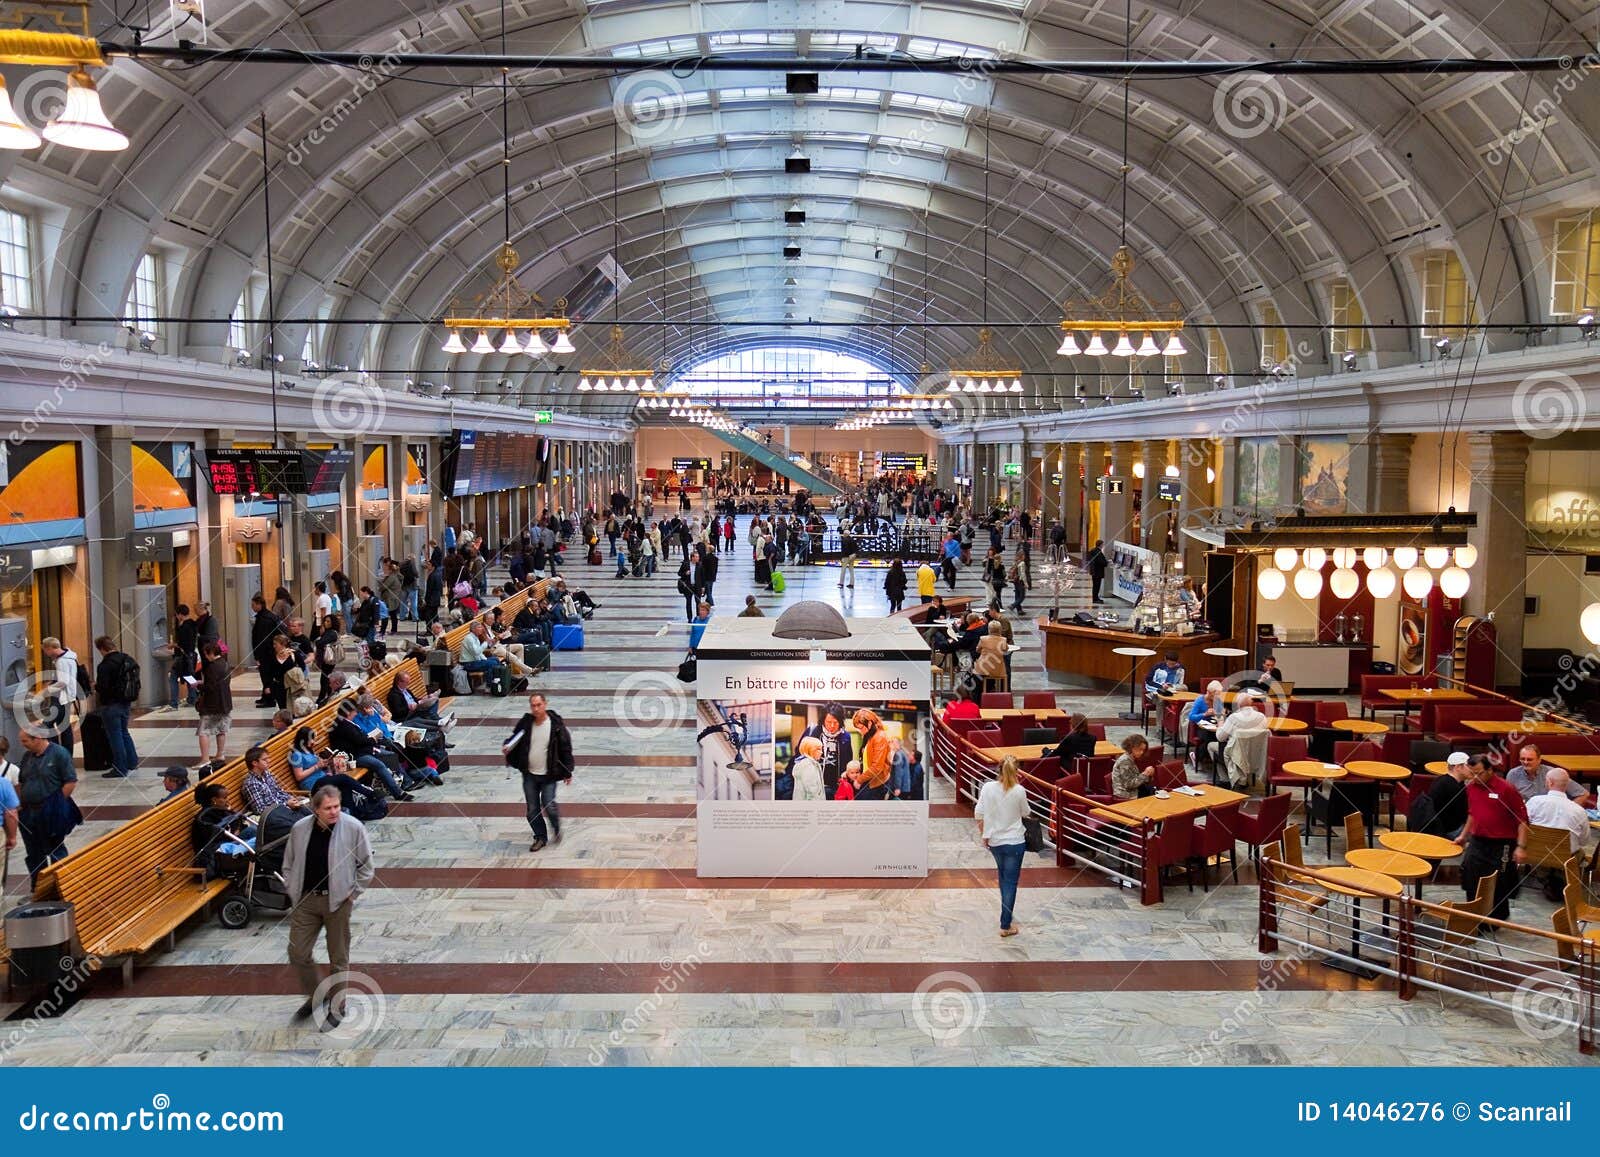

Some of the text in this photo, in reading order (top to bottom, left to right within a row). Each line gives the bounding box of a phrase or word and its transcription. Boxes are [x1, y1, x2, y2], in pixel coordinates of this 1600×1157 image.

[725, 677, 908, 692] En bättre miljö för resande
